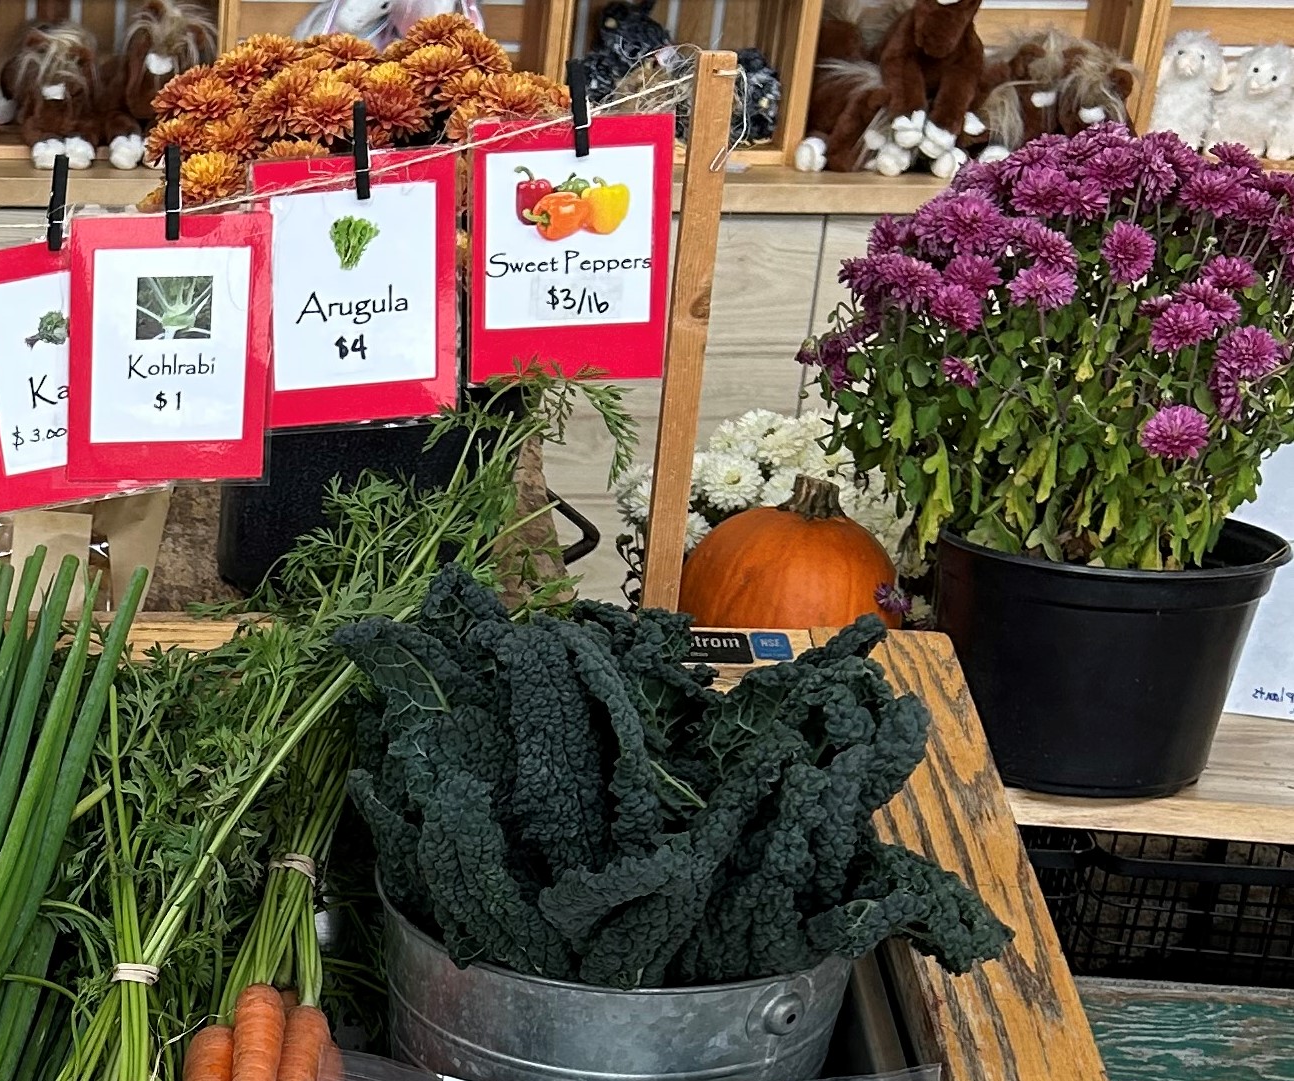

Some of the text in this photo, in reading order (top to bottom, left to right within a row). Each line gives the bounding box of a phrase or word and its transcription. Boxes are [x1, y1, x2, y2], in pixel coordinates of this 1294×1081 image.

[485, 250, 653, 278] Sweet Peppers
[295, 283, 409, 325] Arugula
[334, 333, 368, 360] $4
[127, 352, 216, 379] Kohlrabi
[28, 374, 70, 409] Ka
[690, 635, 741, 648] trom
